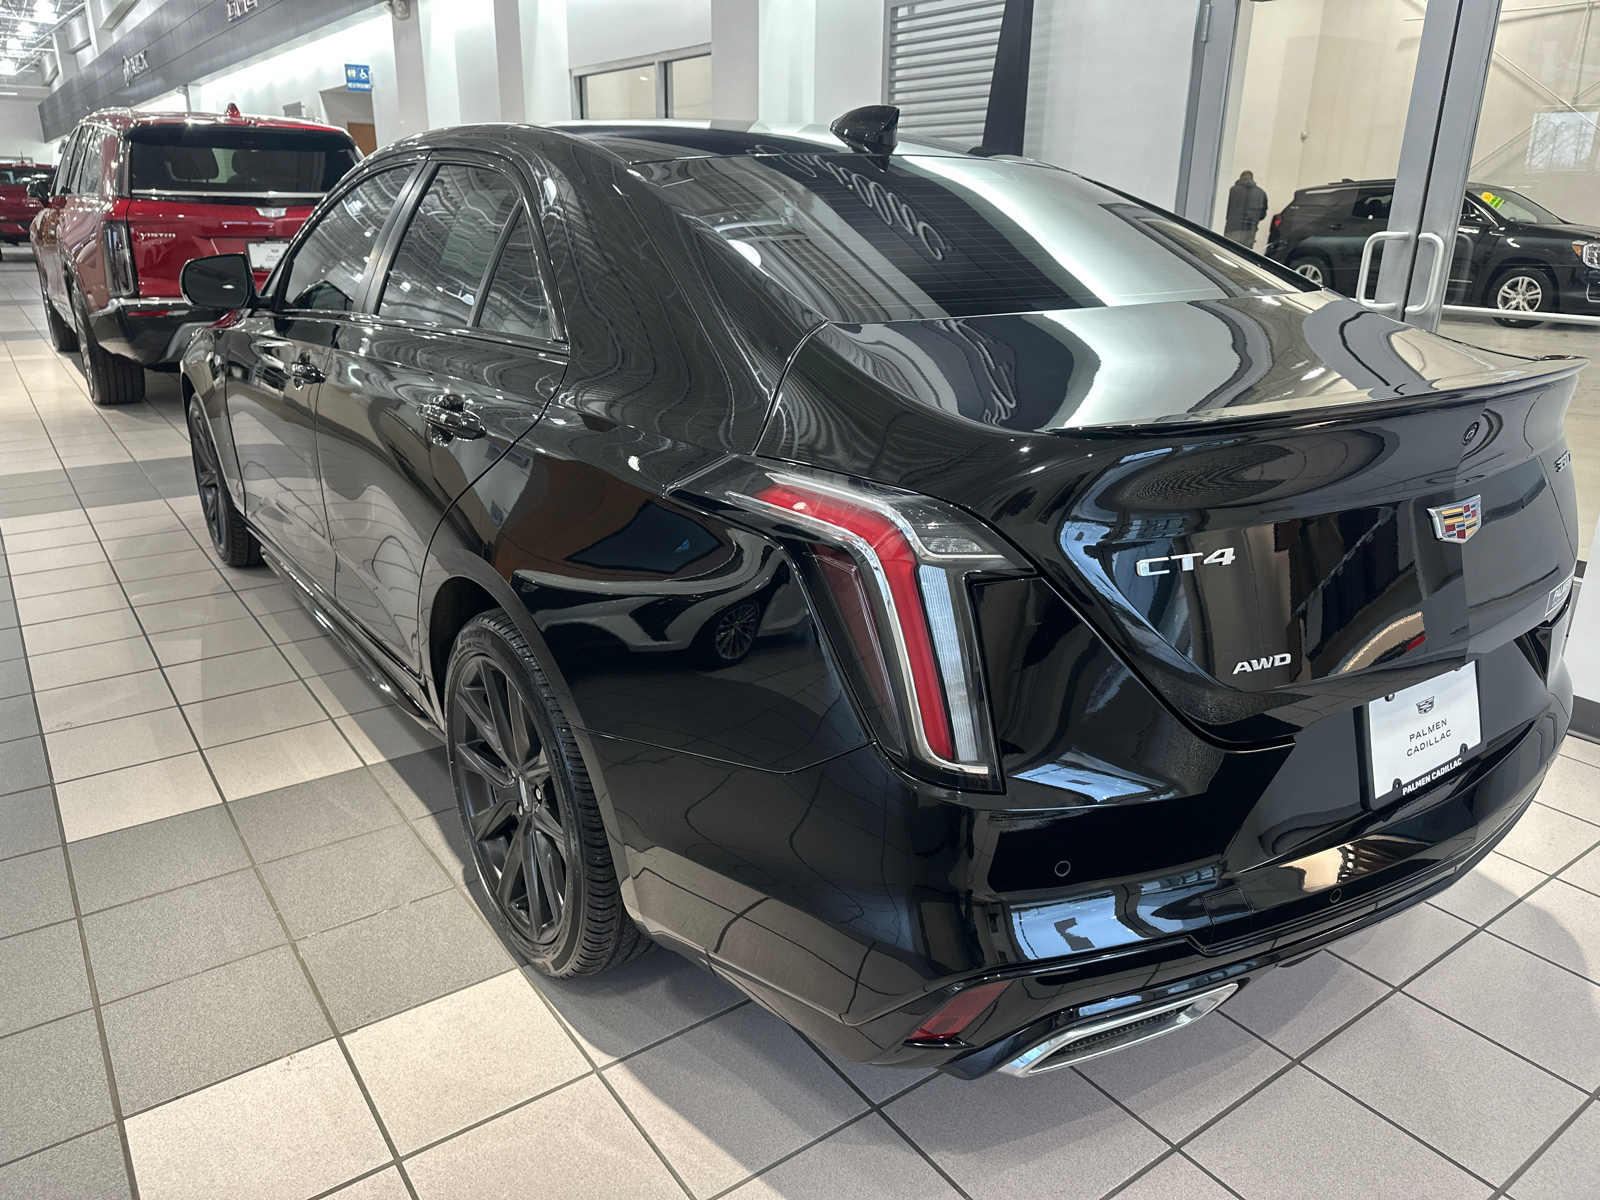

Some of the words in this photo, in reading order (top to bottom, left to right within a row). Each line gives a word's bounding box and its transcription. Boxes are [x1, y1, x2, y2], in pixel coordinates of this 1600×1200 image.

[1134, 547, 1236, 577] CT4
[1232, 653, 1292, 675] AWD
[1406, 729, 1452, 757] CADILLAC
[1408, 718, 1448, 742] PALMEN
[1402, 774, 1431, 796] PALMEN
[1431, 758, 1463, 780] CADILLAC
